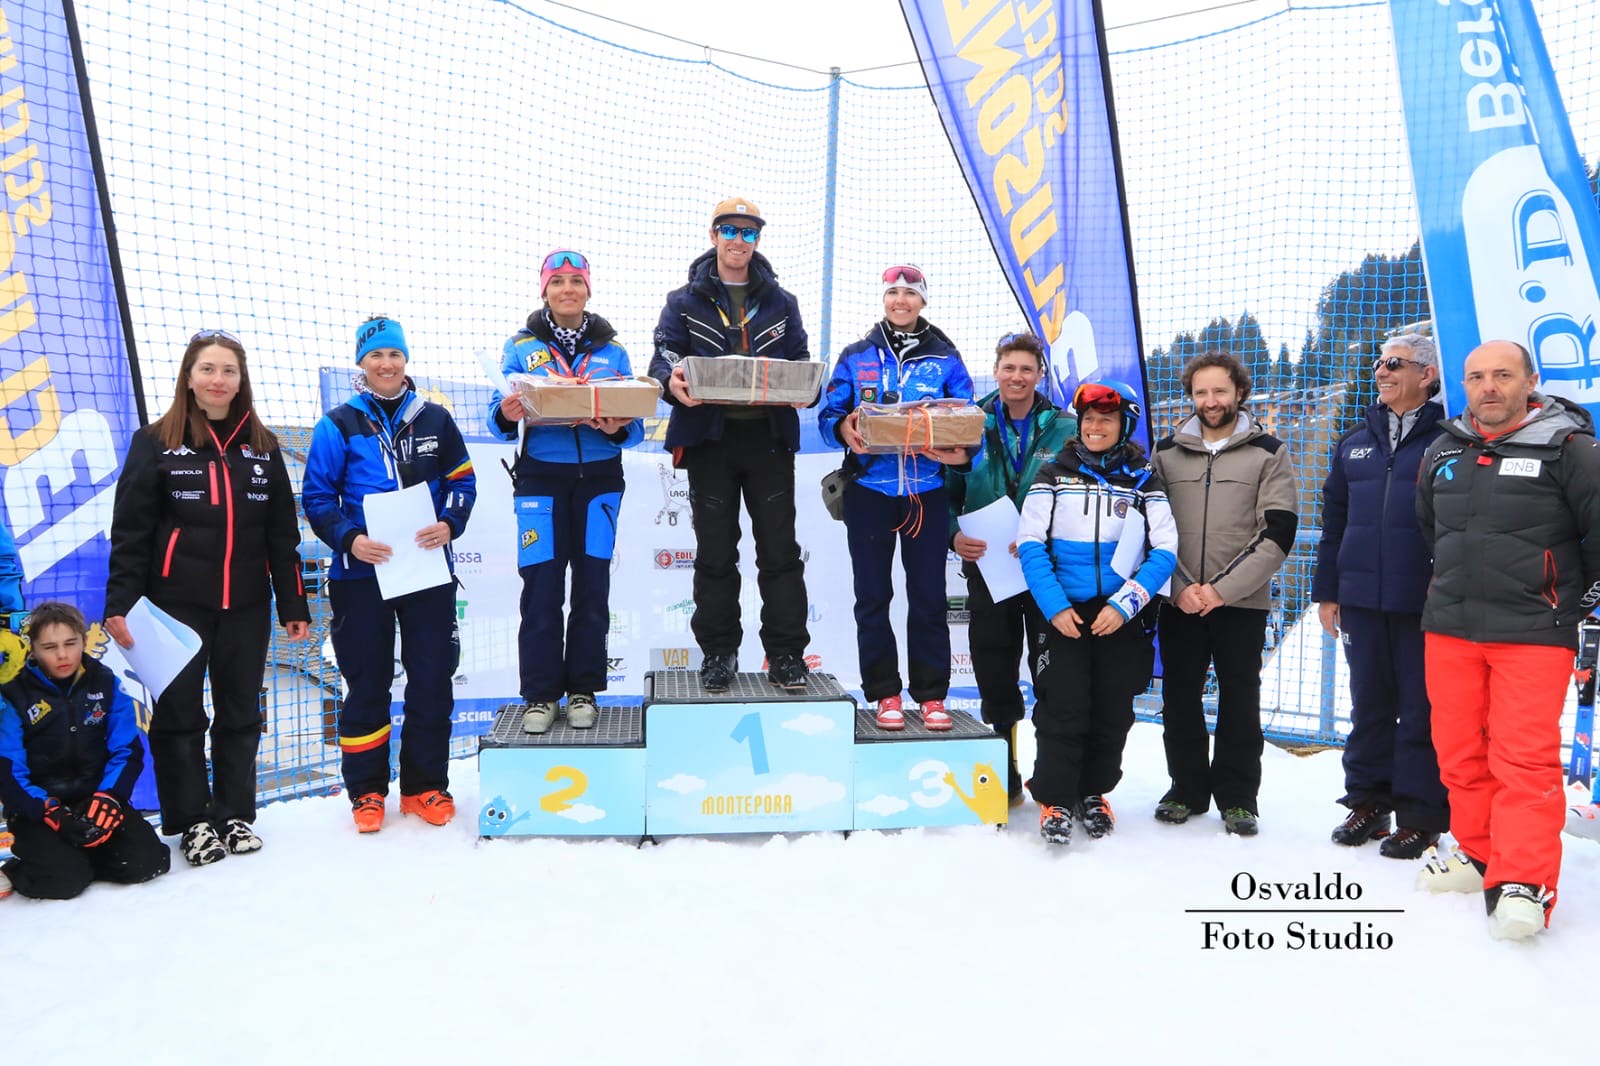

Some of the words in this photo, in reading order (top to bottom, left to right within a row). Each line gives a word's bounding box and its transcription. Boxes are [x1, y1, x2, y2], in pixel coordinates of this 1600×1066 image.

[1437, 0, 1527, 133] Ber
[1504, 459, 1535, 473] DNB
[675, 551, 694, 560] EDIL
[662, 648, 689, 666] VAR
[452, 710, 498, 724] _SCIAL
[729, 712, 770, 776] 1
[539, 765, 588, 813] 2
[908, 759, 954, 808] 3
[702, 794, 793, 815] MONTEPORA
